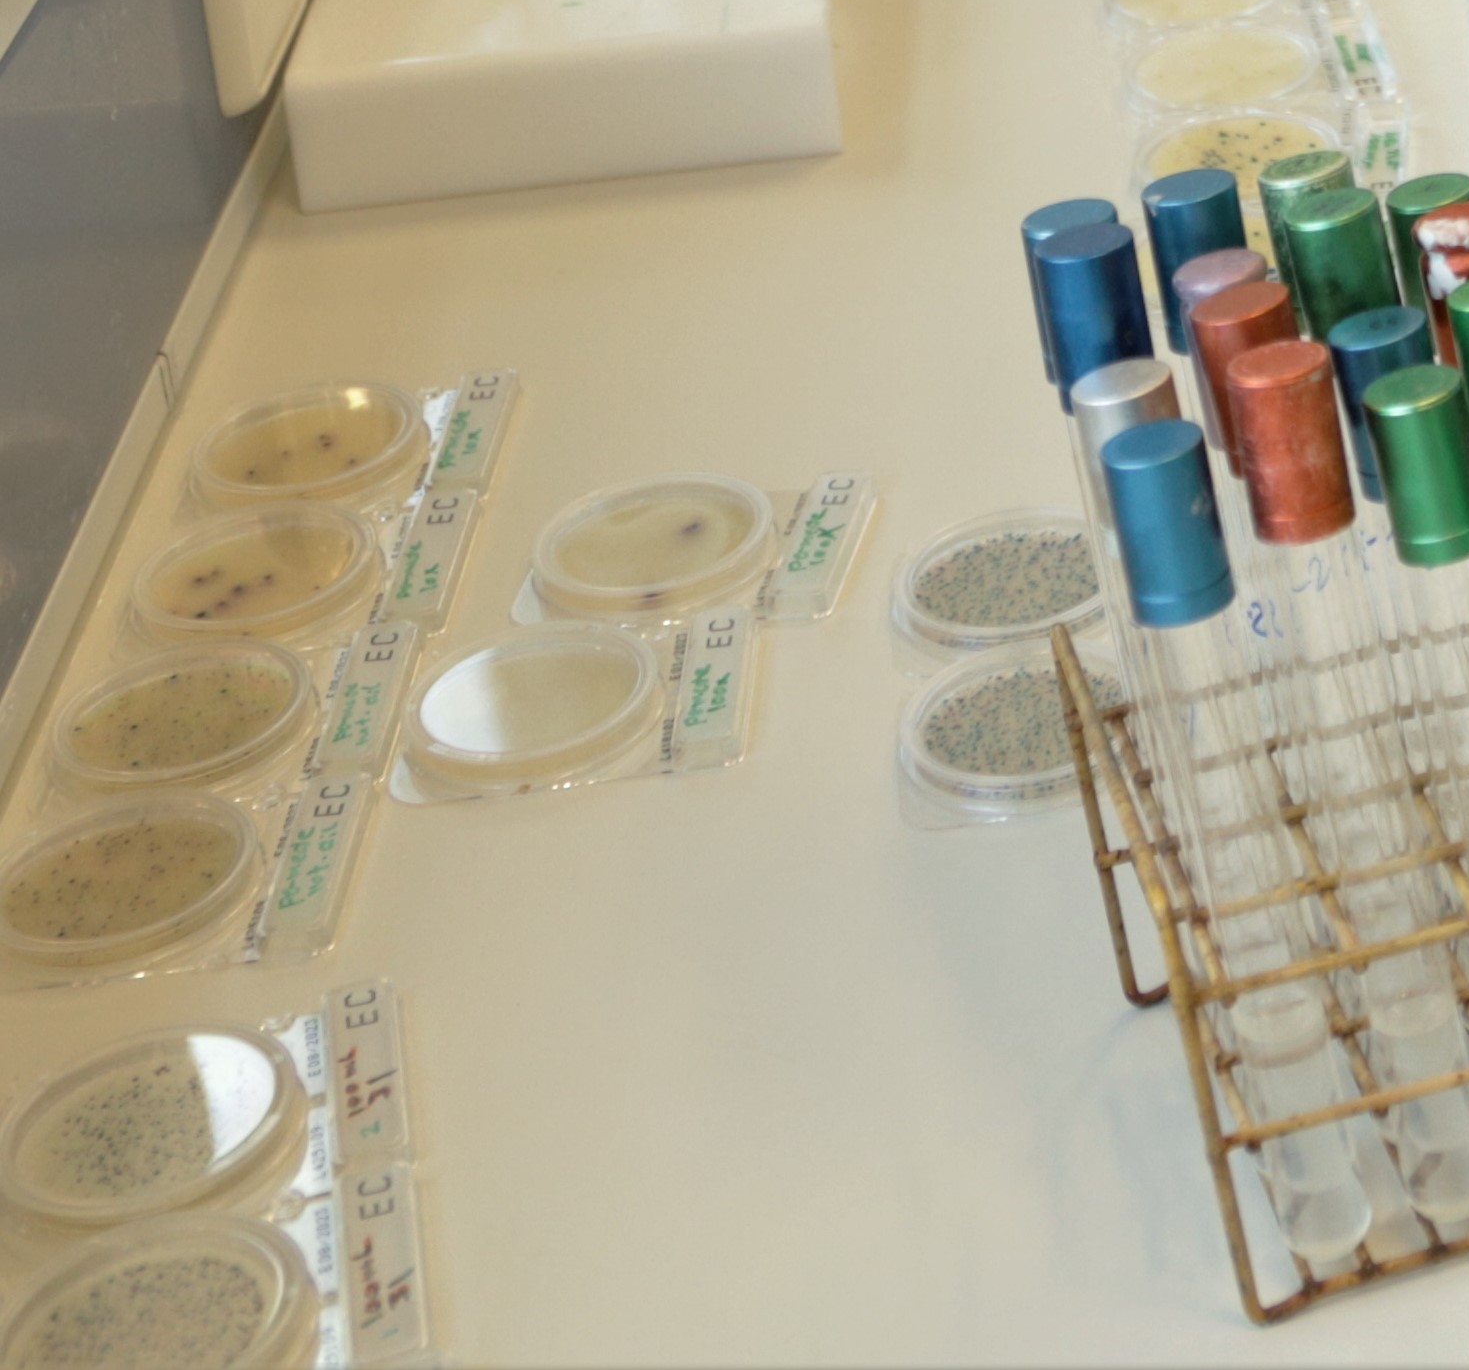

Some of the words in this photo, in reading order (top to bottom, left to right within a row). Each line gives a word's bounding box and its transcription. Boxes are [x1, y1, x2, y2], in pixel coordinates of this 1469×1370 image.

[470, 374, 500, 402] EC
[822, 478, 855, 507] EC
[427, 496, 460, 526] EC
[364, 631, 400, 665] EC
[707, 618, 736, 649] EC
[314, 783, 351, 820] EC
[344, 988, 379, 1029] EC
[358, 1174, 395, 1221] EC
